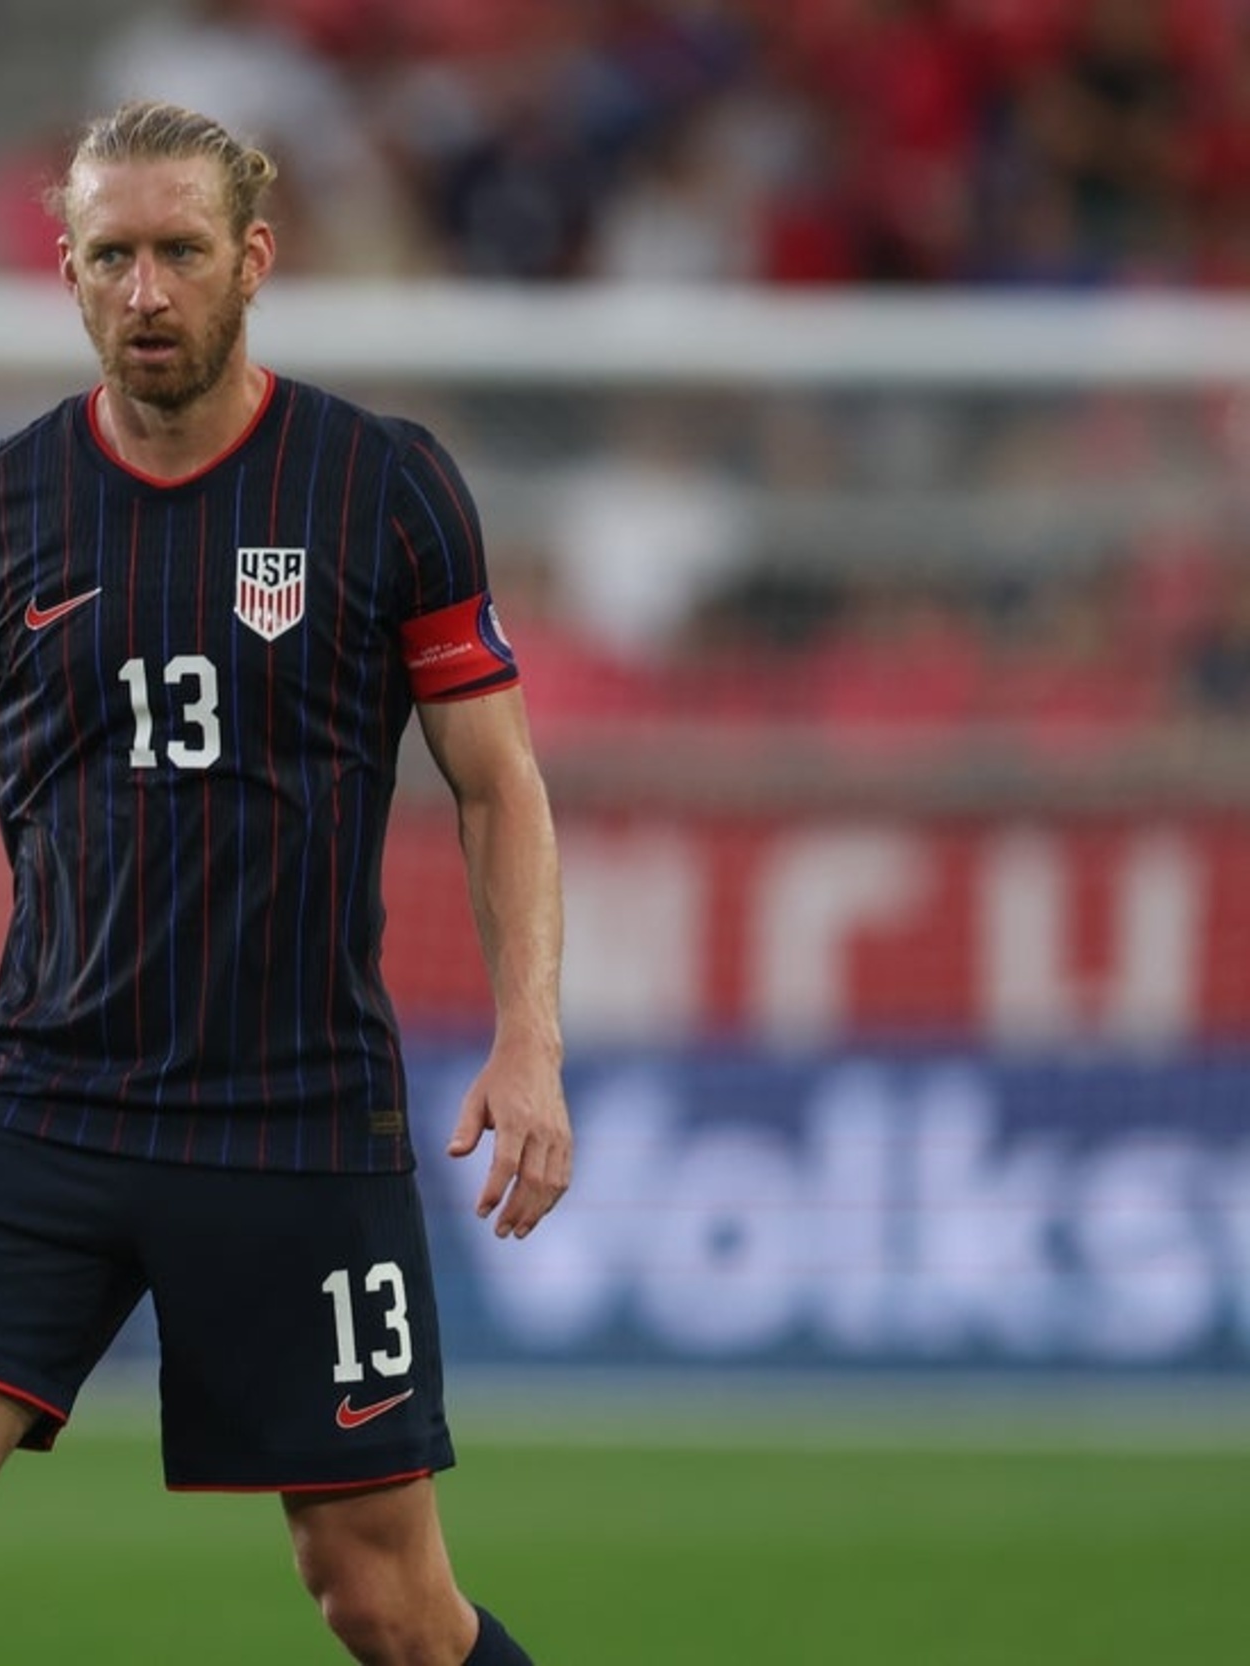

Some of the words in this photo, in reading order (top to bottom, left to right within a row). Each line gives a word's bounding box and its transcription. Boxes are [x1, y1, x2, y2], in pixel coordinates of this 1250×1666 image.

[241, 552, 301, 587] USA
[118, 655, 221, 769] 13
[435, 1060, 1250, 1357] Volks
[322, 1261, 412, 1383] 13
